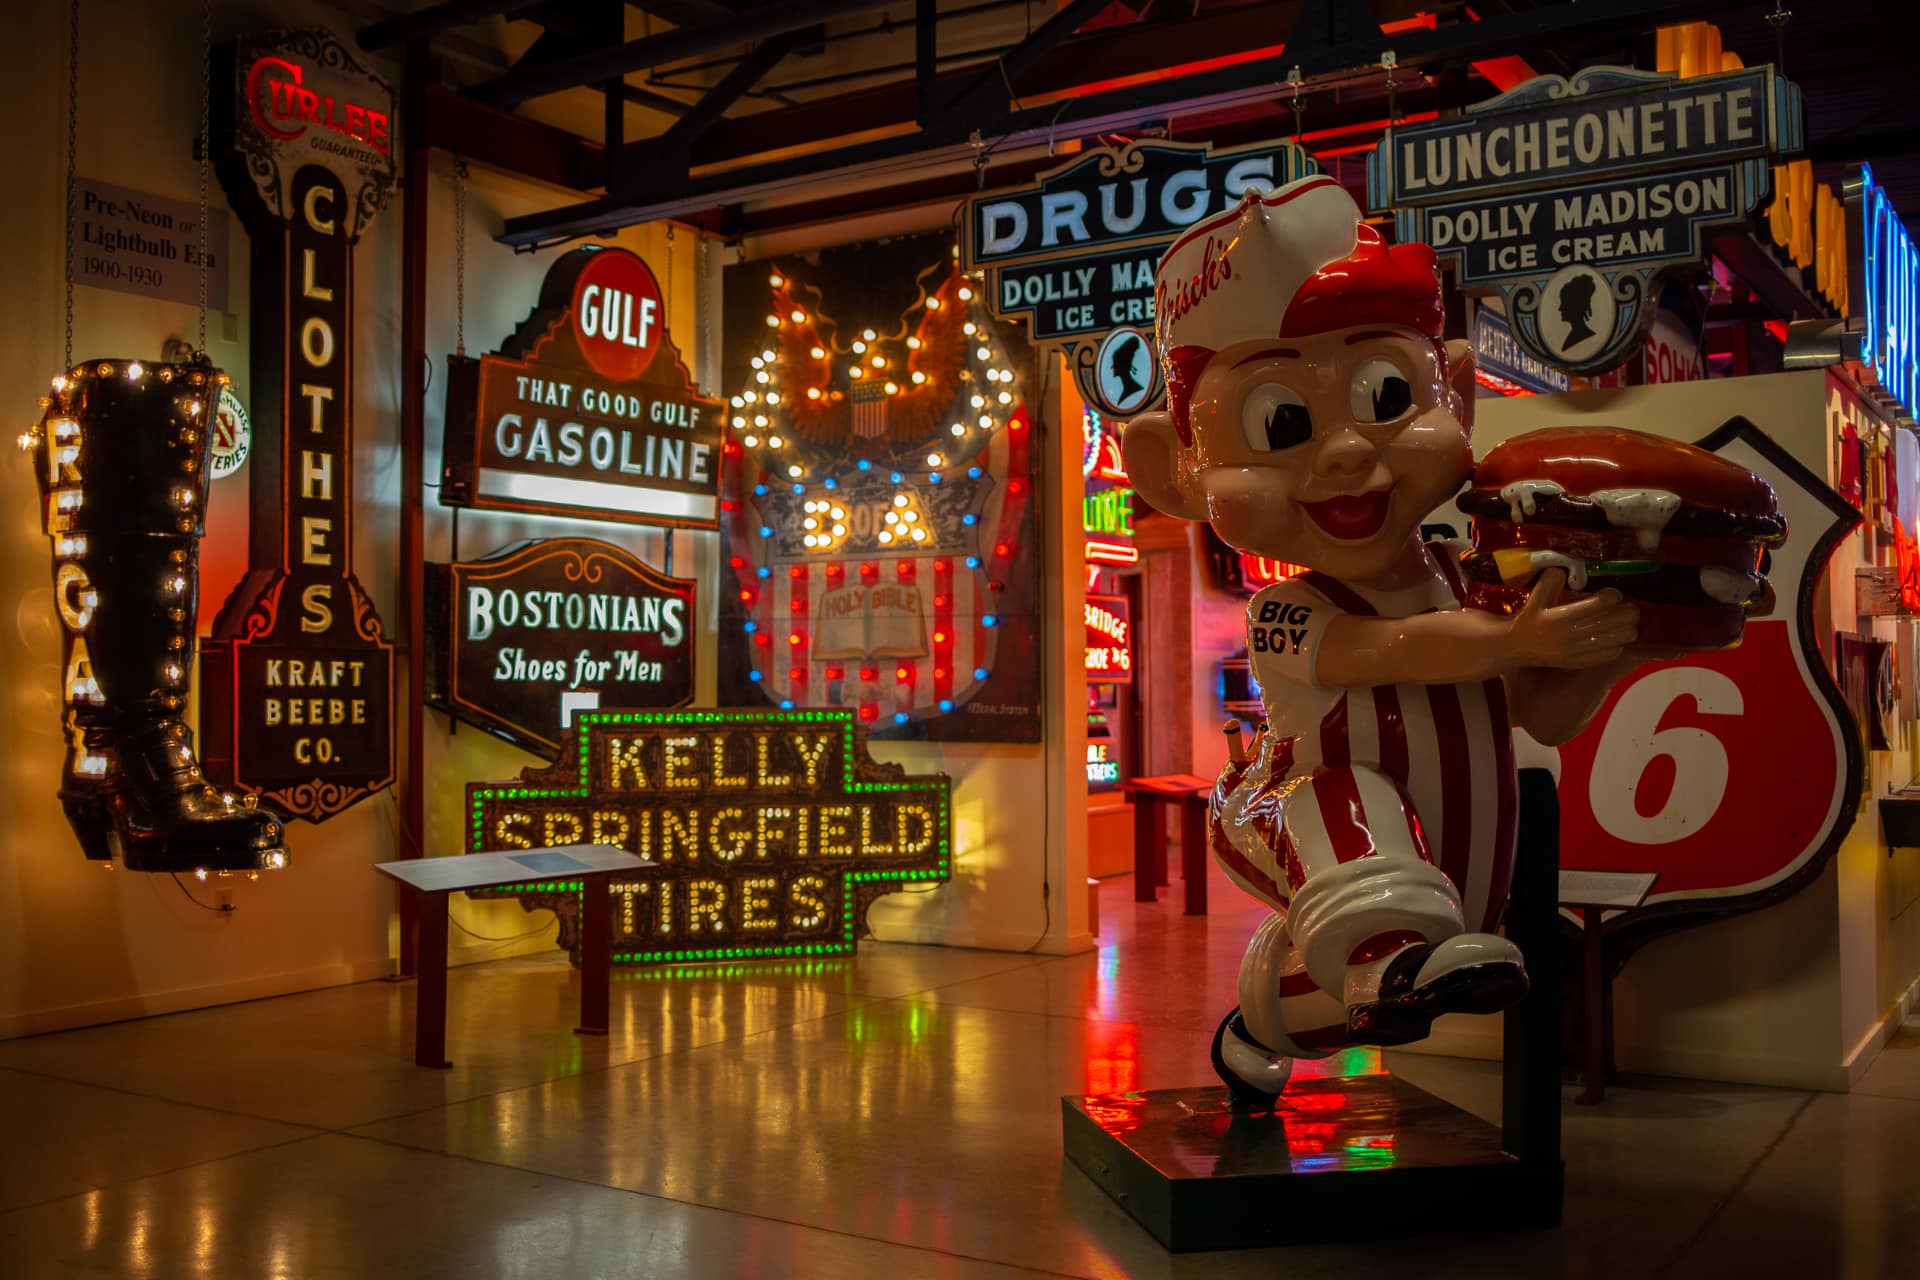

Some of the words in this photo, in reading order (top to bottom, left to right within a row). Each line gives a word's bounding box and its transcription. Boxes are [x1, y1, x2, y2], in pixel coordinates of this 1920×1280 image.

[247, 56, 390, 155] CURLEE
[1403, 87, 1754, 189] LUNCHEONETTE
[83, 190, 174, 230] Pre-Neon
[178, 219, 196, 234] or
[981, 156, 1275, 255] DRUGS
[1431, 203, 1537, 248] DOLLY
[1554, 175, 1728, 232] MADISON
[83, 222, 177, 260] Lightbulb
[1488, 245, 1537, 273] ICE
[1552, 227, 1665, 266] CREAM
[83, 256, 163, 288] 1900-1930
[1003, 266, 1097, 308] DOLLY
[580, 284, 657, 349] GULF
[1056, 304, 1095, 331] ICE
[1110, 297, 1156, 323] CRE
[301, 186, 335, 634] CLOTHES
[516, 375, 572, 408] THAT
[583, 388, 641, 420] GOOD
[650, 401, 701, 429] GULF
[495, 413, 711, 484] GASOLINE
[803, 499, 849, 552] D
[877, 489, 938, 549] A
[47, 417, 107, 775] REGAL
[467, 586, 684, 646] BOSTONIANS
[824, 590, 864, 616] HOLY
[871, 589, 918, 614] BIBLE
[1258, 600, 1313, 626] BIG
[495, 648, 567, 682] Shoes
[570, 652, 611, 689] for
[613, 649, 662, 683] Men
[1253, 626, 1308, 656] BOY
[266, 659, 365, 687] KRAFT
[265, 699, 366, 726] BEEBE
[294, 737, 341, 764] CO.
[610, 734, 830, 790] KELLY
[1514, 666, 1744, 845] 6
[495, 803, 934, 862] SPRINGFIELD
[609, 875, 827, 934] TIRES
